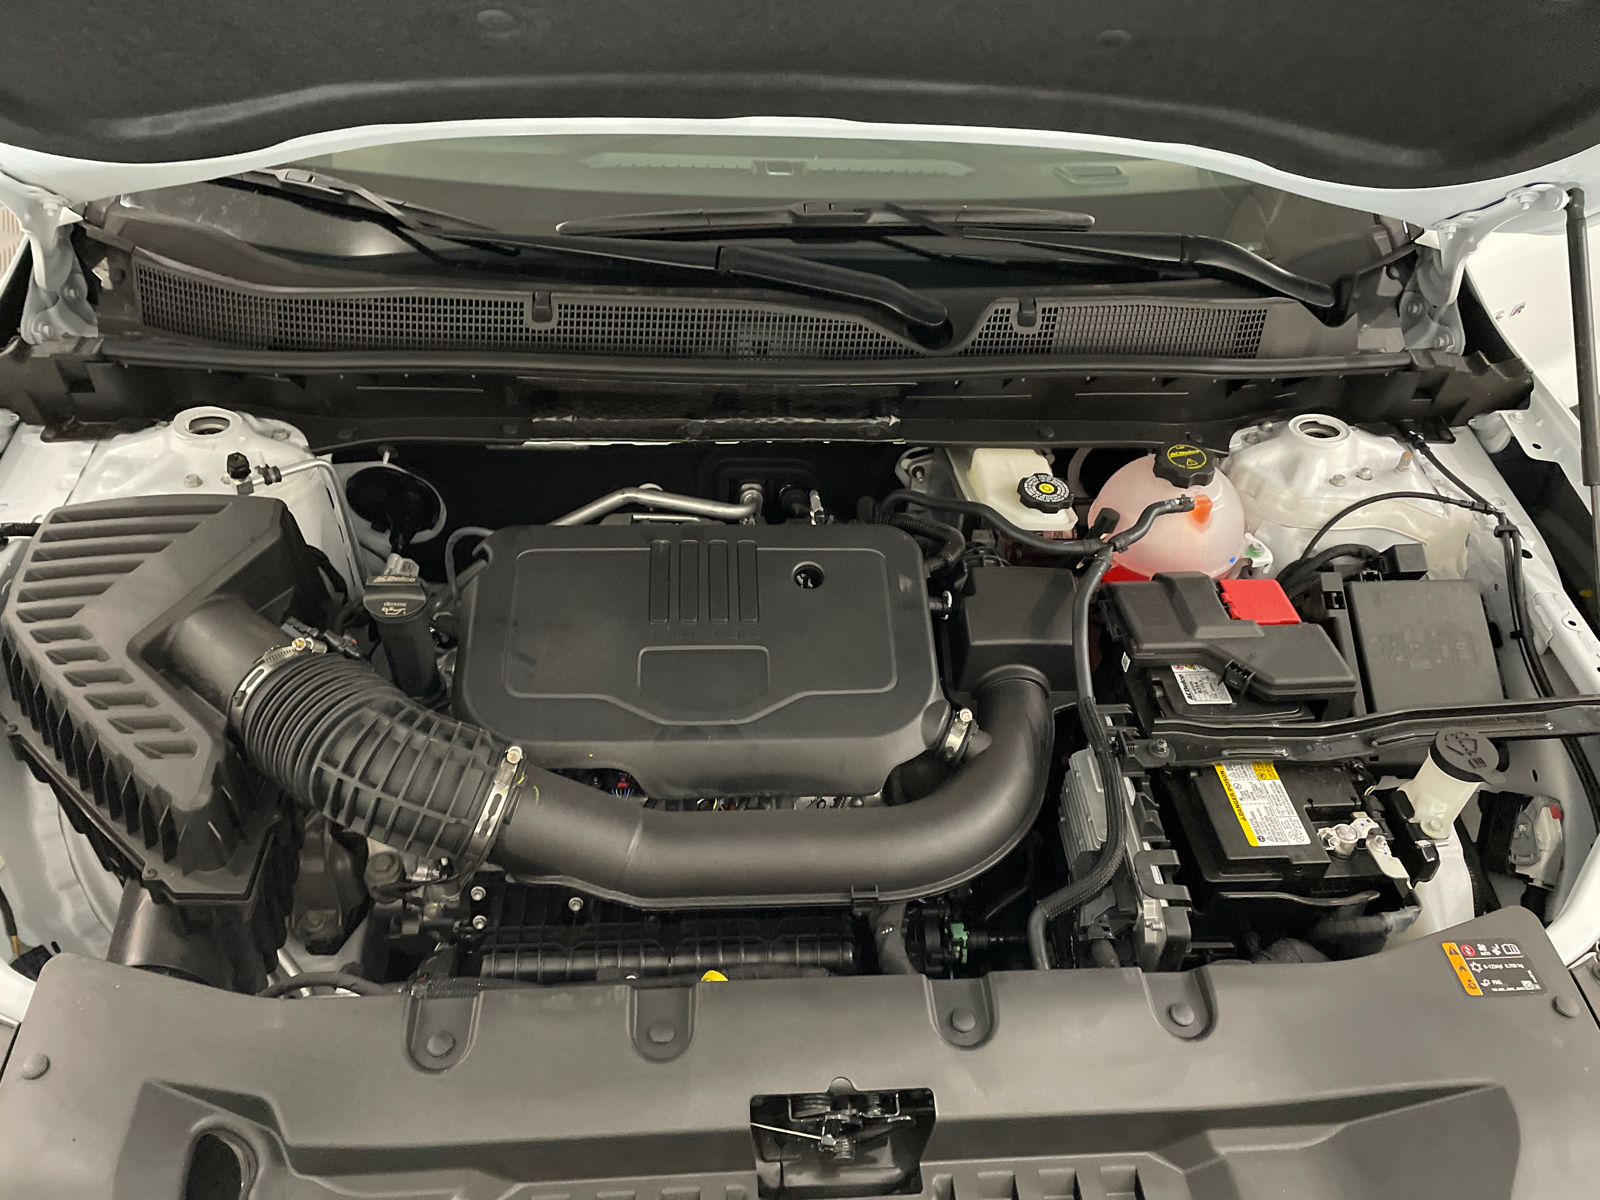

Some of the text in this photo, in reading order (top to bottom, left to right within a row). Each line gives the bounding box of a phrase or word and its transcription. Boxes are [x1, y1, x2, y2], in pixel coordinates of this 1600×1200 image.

[373, 575, 416, 583] ACDelco
[1220, 770, 1244, 819] DANGER POISON
